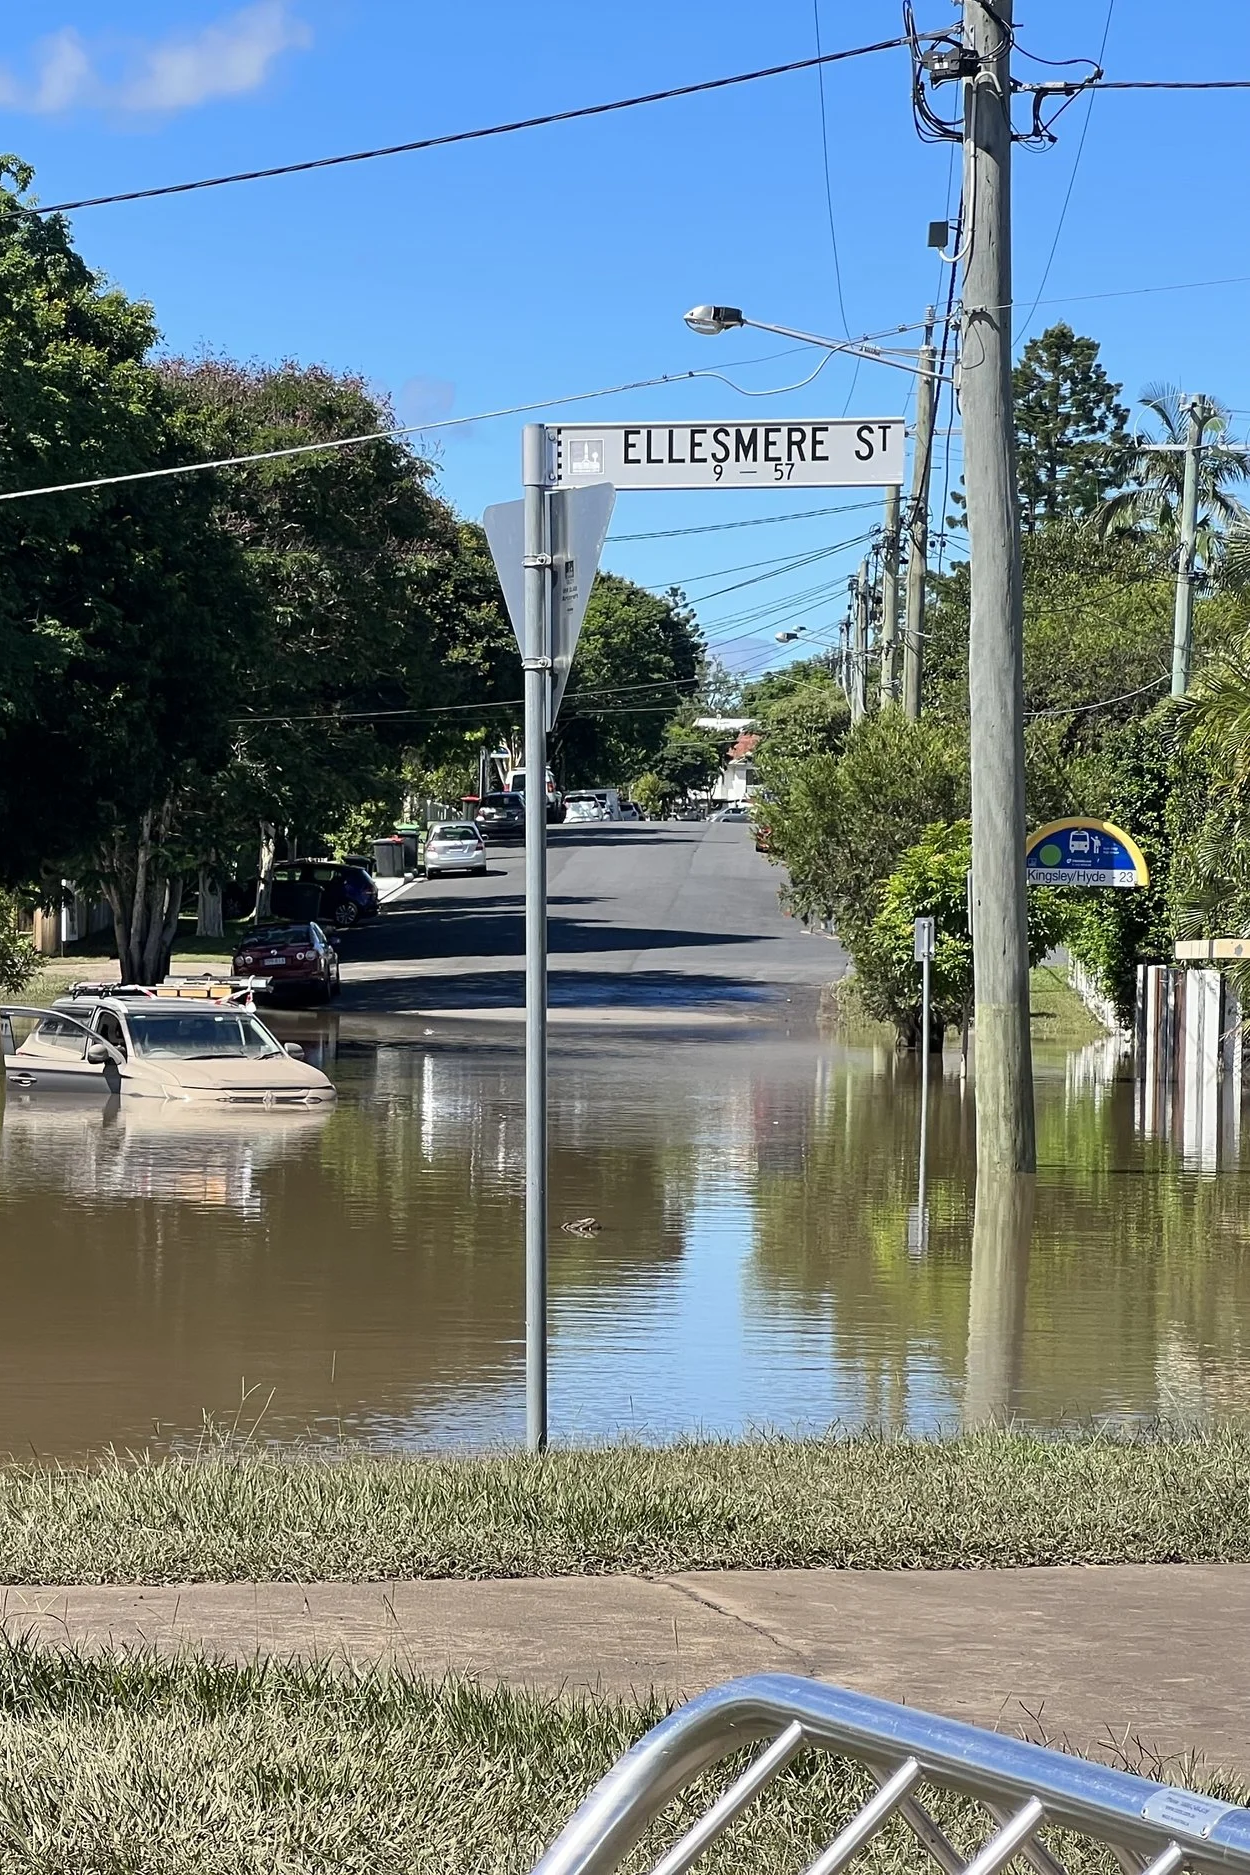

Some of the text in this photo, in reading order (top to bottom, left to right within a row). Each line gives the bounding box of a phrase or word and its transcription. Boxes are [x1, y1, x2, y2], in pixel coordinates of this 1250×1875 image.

[623, 425, 892, 464] ELLESMERE ST
[712, 464, 724, 482] 9
[774, 463, 796, 481] 57
[1027, 869, 1106, 885] Kingsley/Hyde
[1119, 871, 1134, 883] 23
